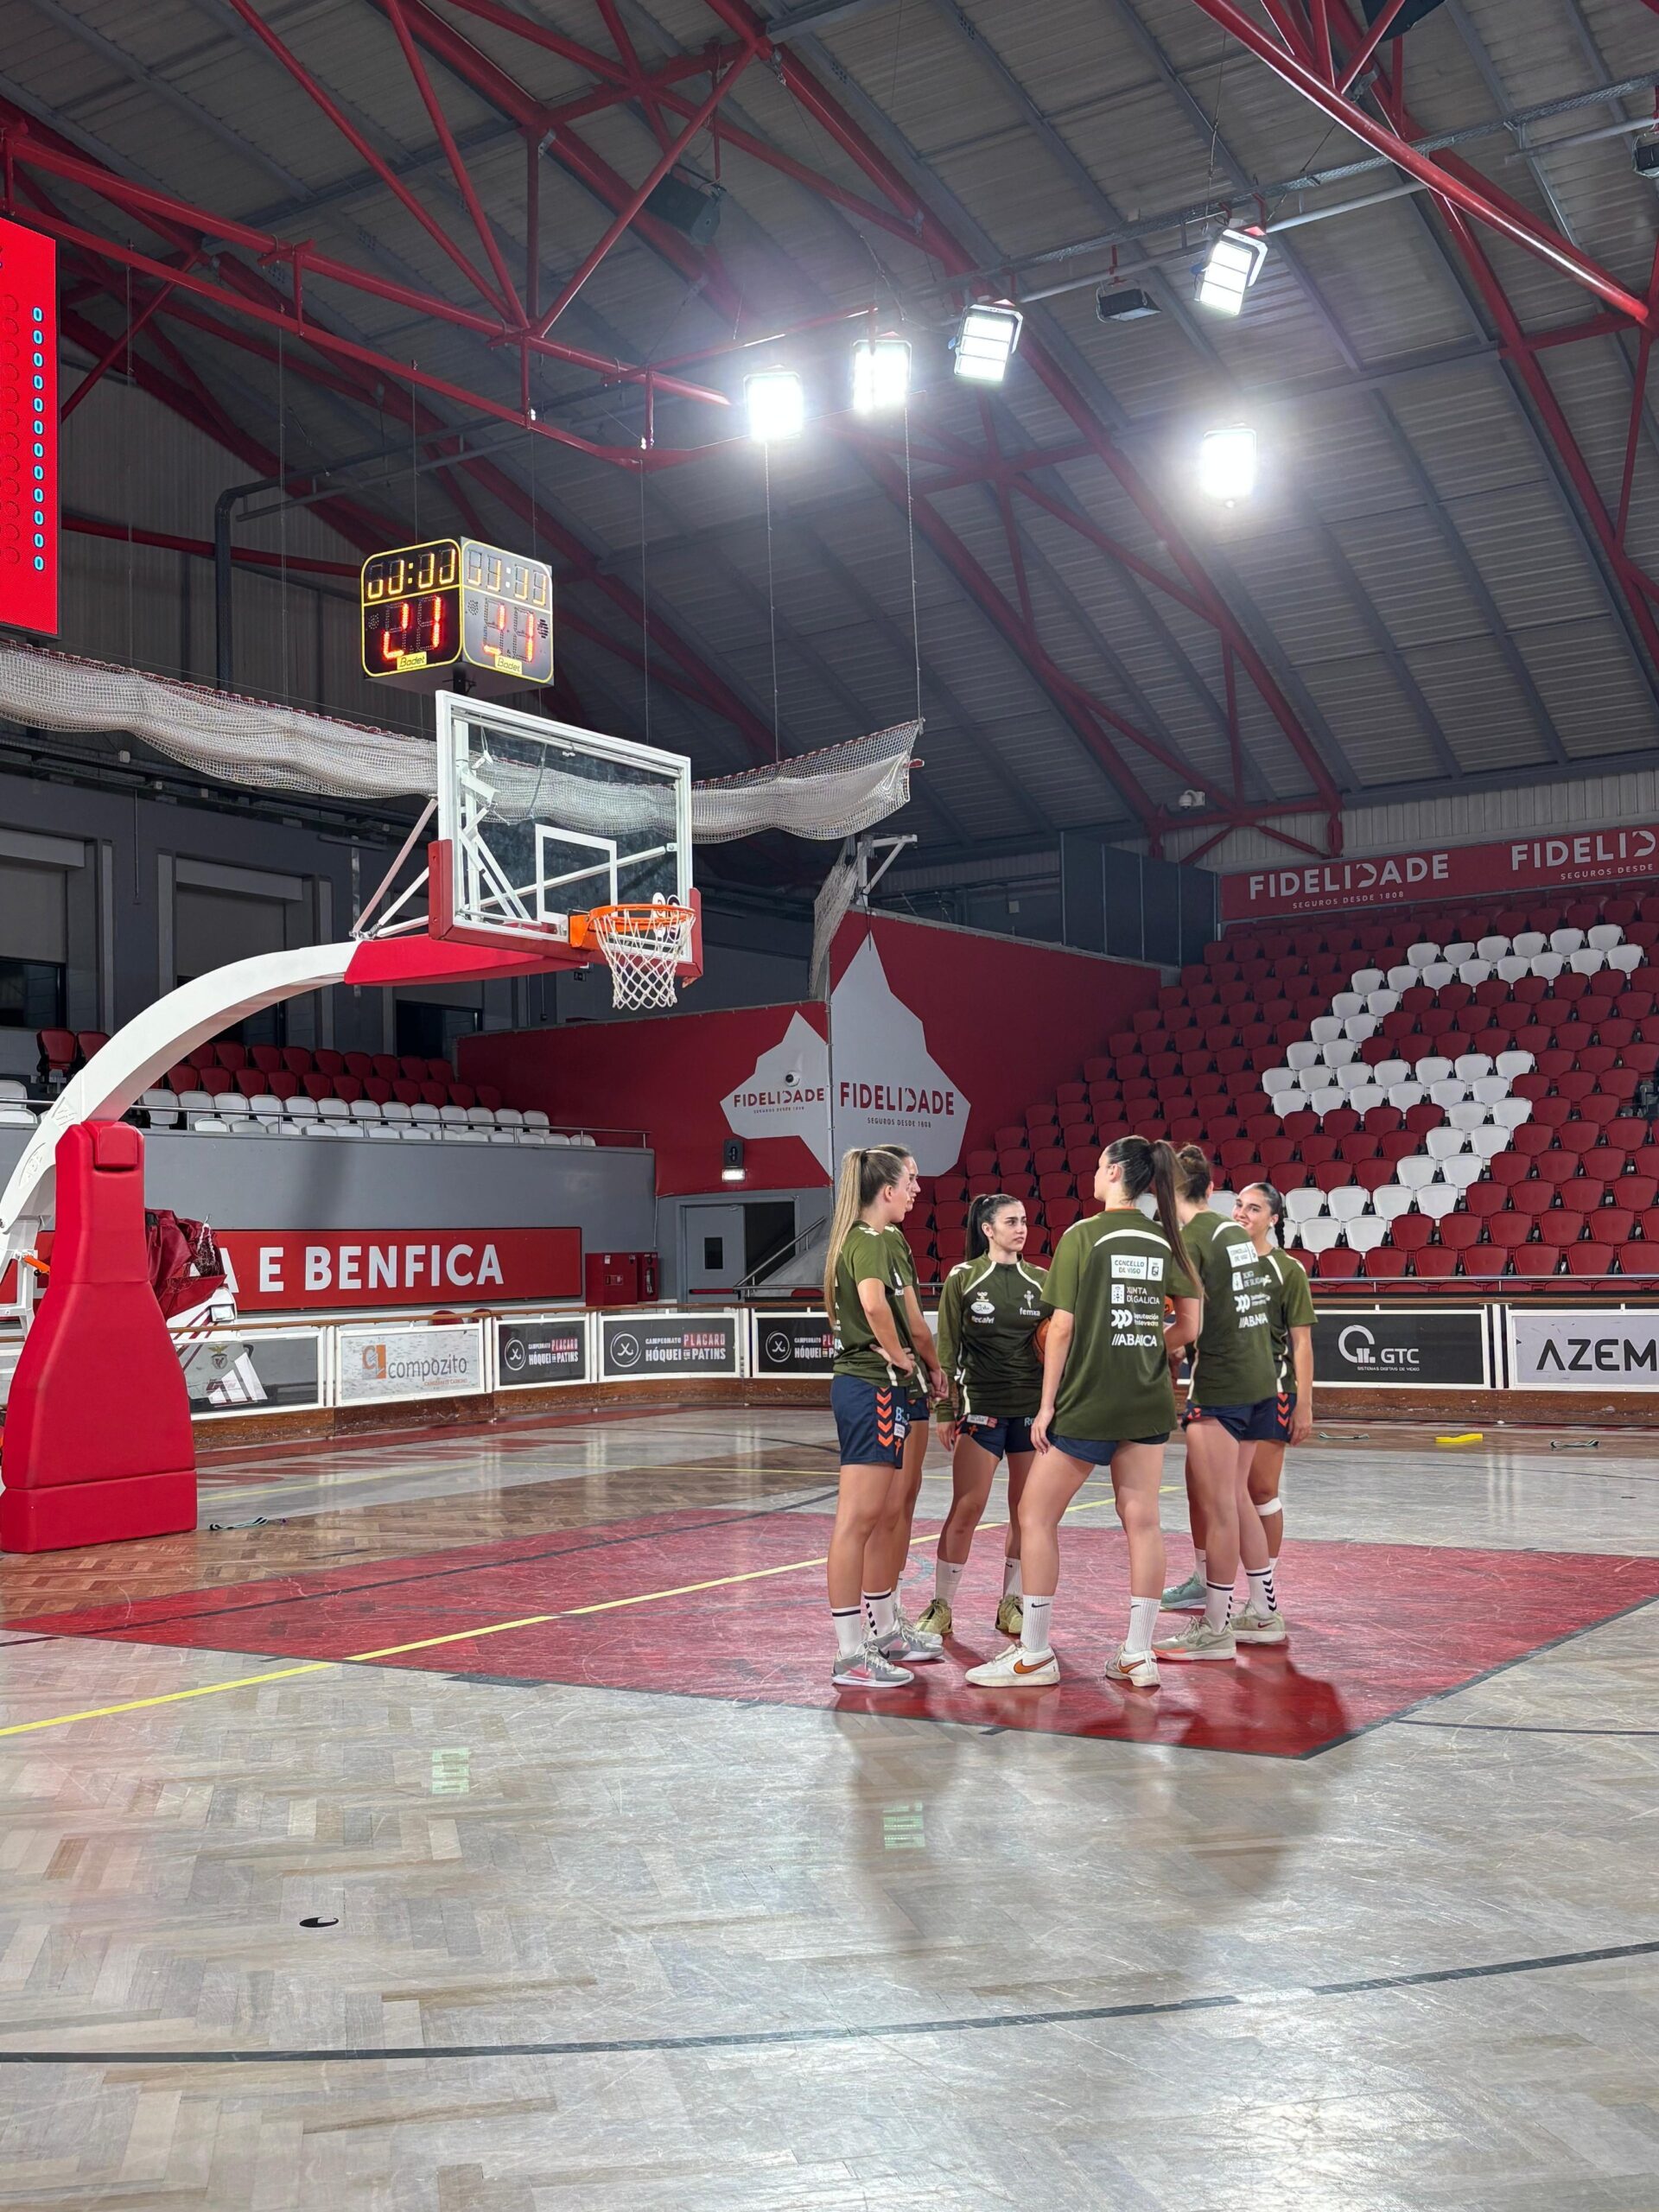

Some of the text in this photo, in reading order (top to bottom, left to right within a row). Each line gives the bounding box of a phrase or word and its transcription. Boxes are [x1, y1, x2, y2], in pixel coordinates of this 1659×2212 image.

[1249, 854, 1449, 900] FIDELIDADE
[1560, 863, 1653, 880] SEGUROS DESDE
[1293, 891, 1404, 909] SEGUROS DESDE 1808
[734, 1088, 824, 1108] FIDELIDADE
[841, 1082, 955, 1116] FIDELIDADE
[868, 1117, 895, 1126] SEGUROS
[260, 1246, 284, 1293] E
[305, 1244, 504, 1291] BENFICA
[1019, 1306, 1041, 1317] femxa
[551, 1338, 578, 1351] PLACARD
[683, 1333, 726, 1346] PLACARD
[529, 1351, 551, 1365] HÓQUEI
[556, 1351, 579, 1363] PATINS
[645, 1347, 682, 1363] HÓQUEI
[692, 1347, 727, 1360] PATINS
[794, 1345, 822, 1359] HÓQUEI
[1381, 1348, 1420, 1364] GTC
[388, 1354, 467, 1382] compozito
